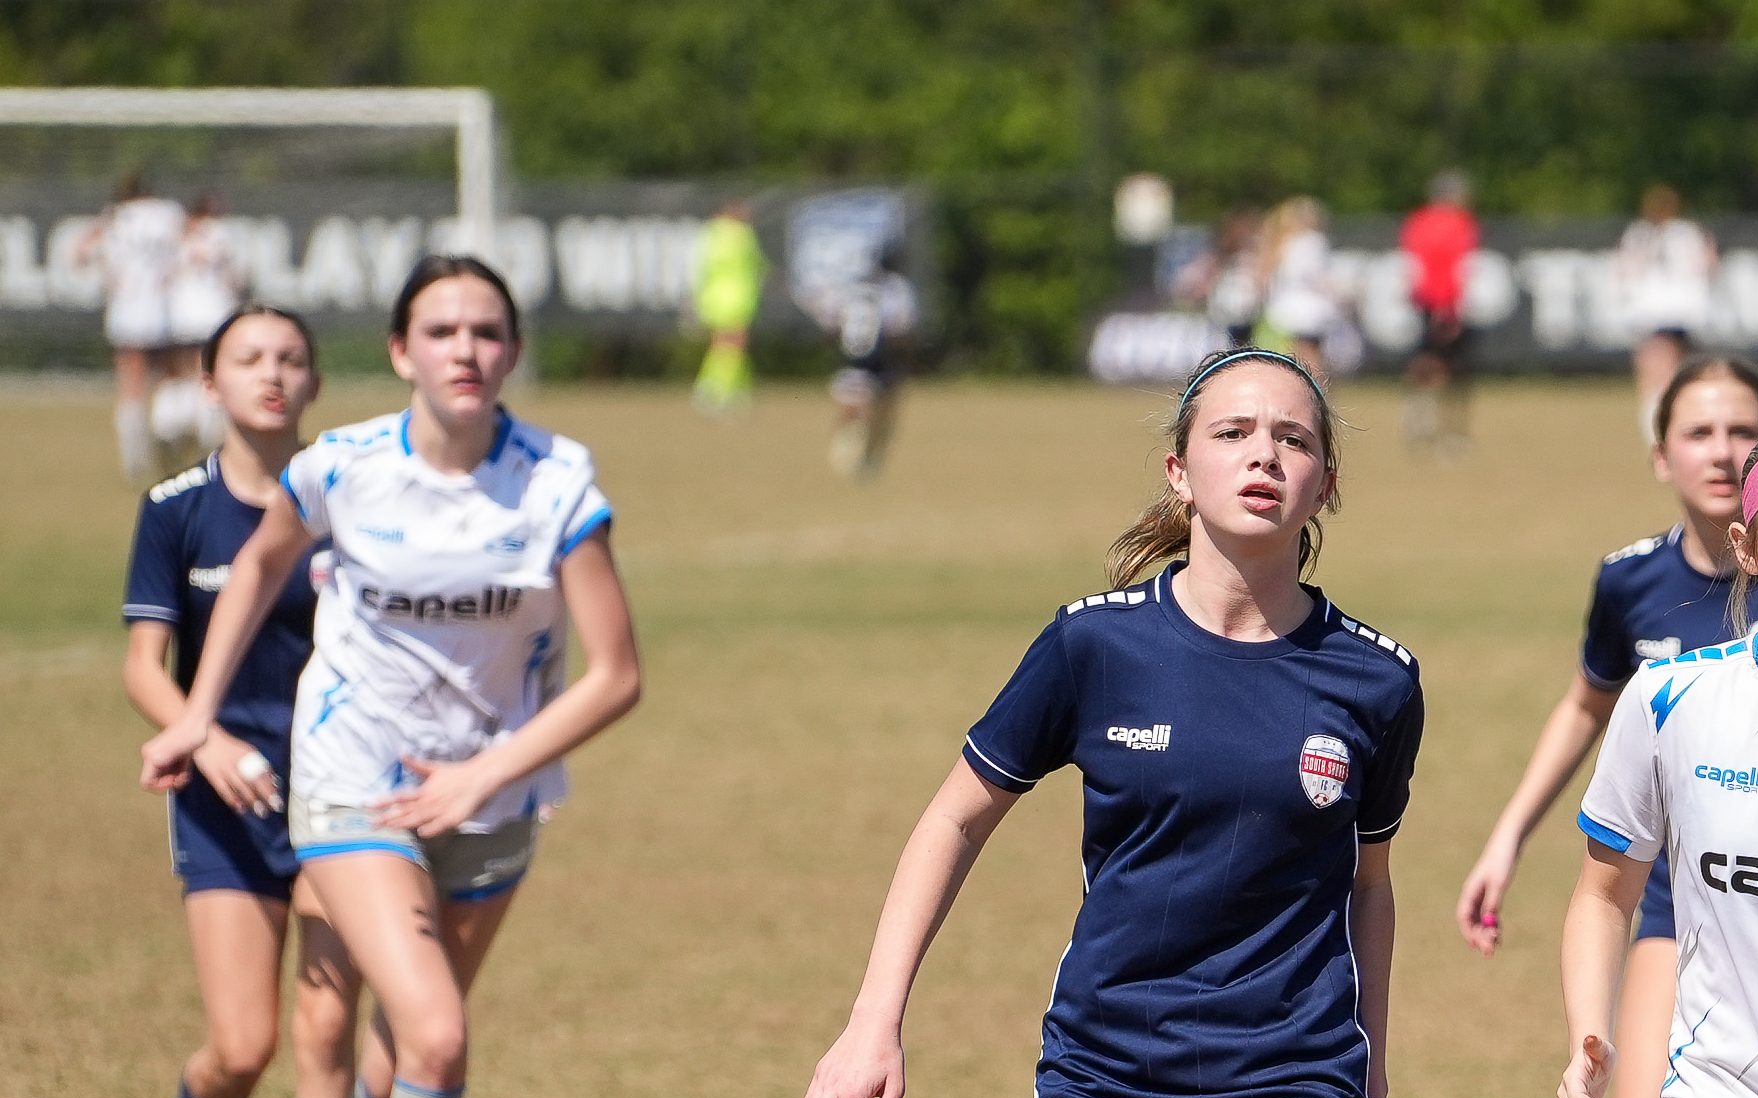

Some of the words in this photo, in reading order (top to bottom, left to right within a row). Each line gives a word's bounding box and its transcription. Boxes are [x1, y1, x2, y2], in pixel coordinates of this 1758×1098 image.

[1107, 724, 1171, 747] capelli
[1131, 742, 1168, 752] SPORT
[1303, 755, 1327, 774] SOUTH
